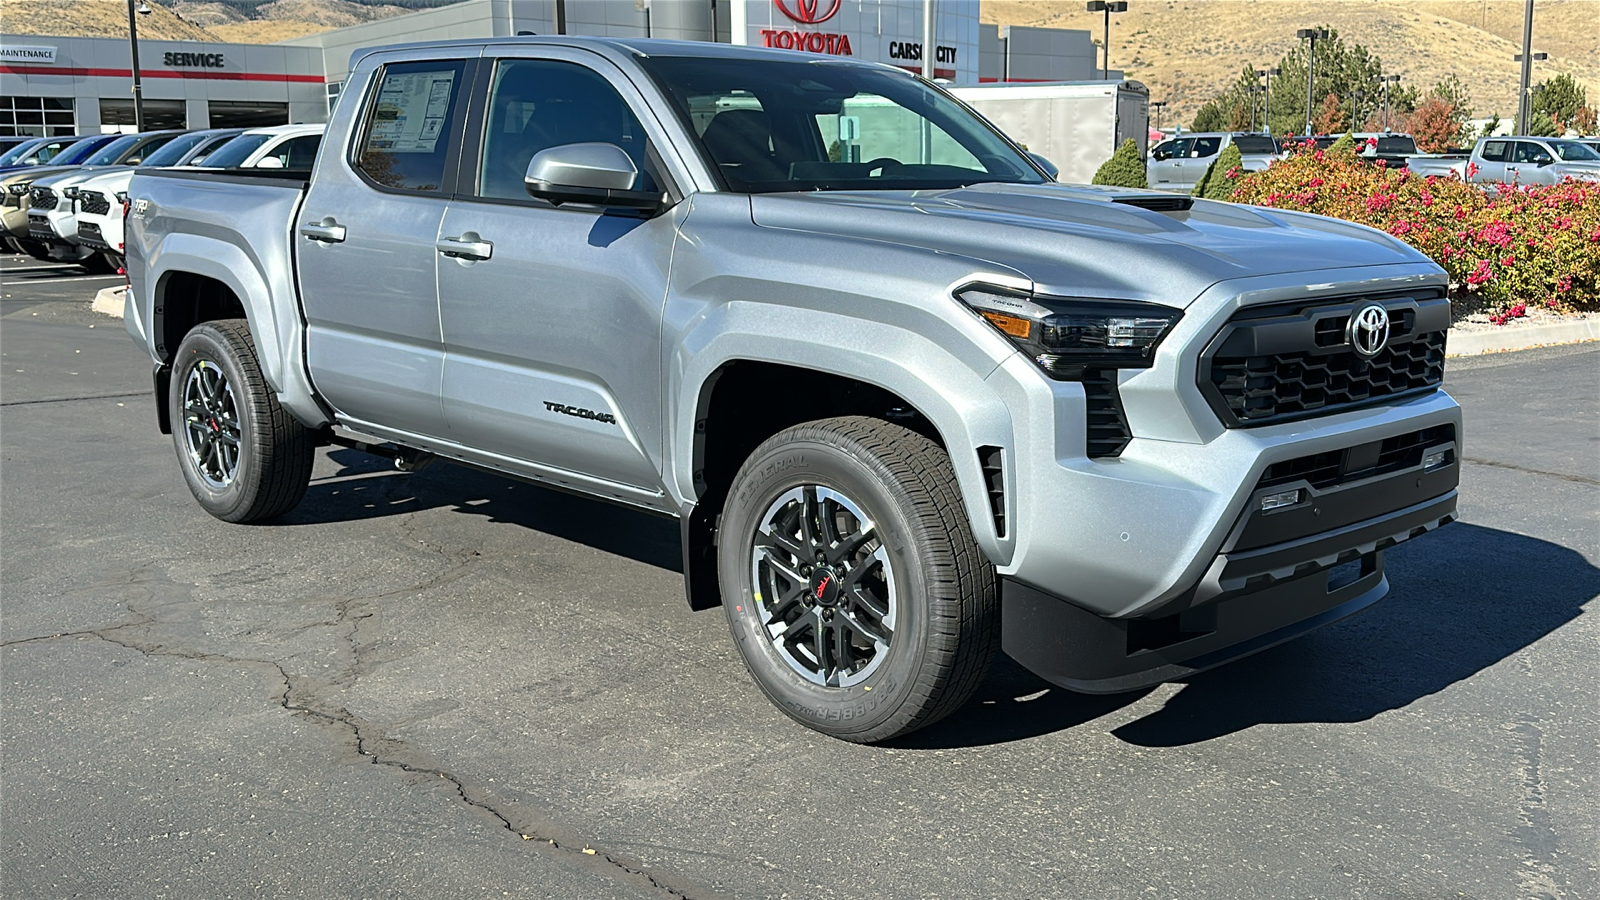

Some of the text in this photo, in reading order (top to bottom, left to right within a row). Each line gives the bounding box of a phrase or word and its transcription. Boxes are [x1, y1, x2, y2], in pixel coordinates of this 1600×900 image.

[760, 29, 852, 55] TOYOTA
[890, 41, 957, 64] CARS CITY
[0, 49, 54, 59] MAINTENANCE
[163, 51, 225, 68] SERVICE
[135, 199, 148, 212] TRD
[543, 401, 616, 425] TACOMA
[740, 455, 809, 510] GENERAL
[816, 576, 831, 599] TRD
[815, 673, 898, 721] GRABBER
